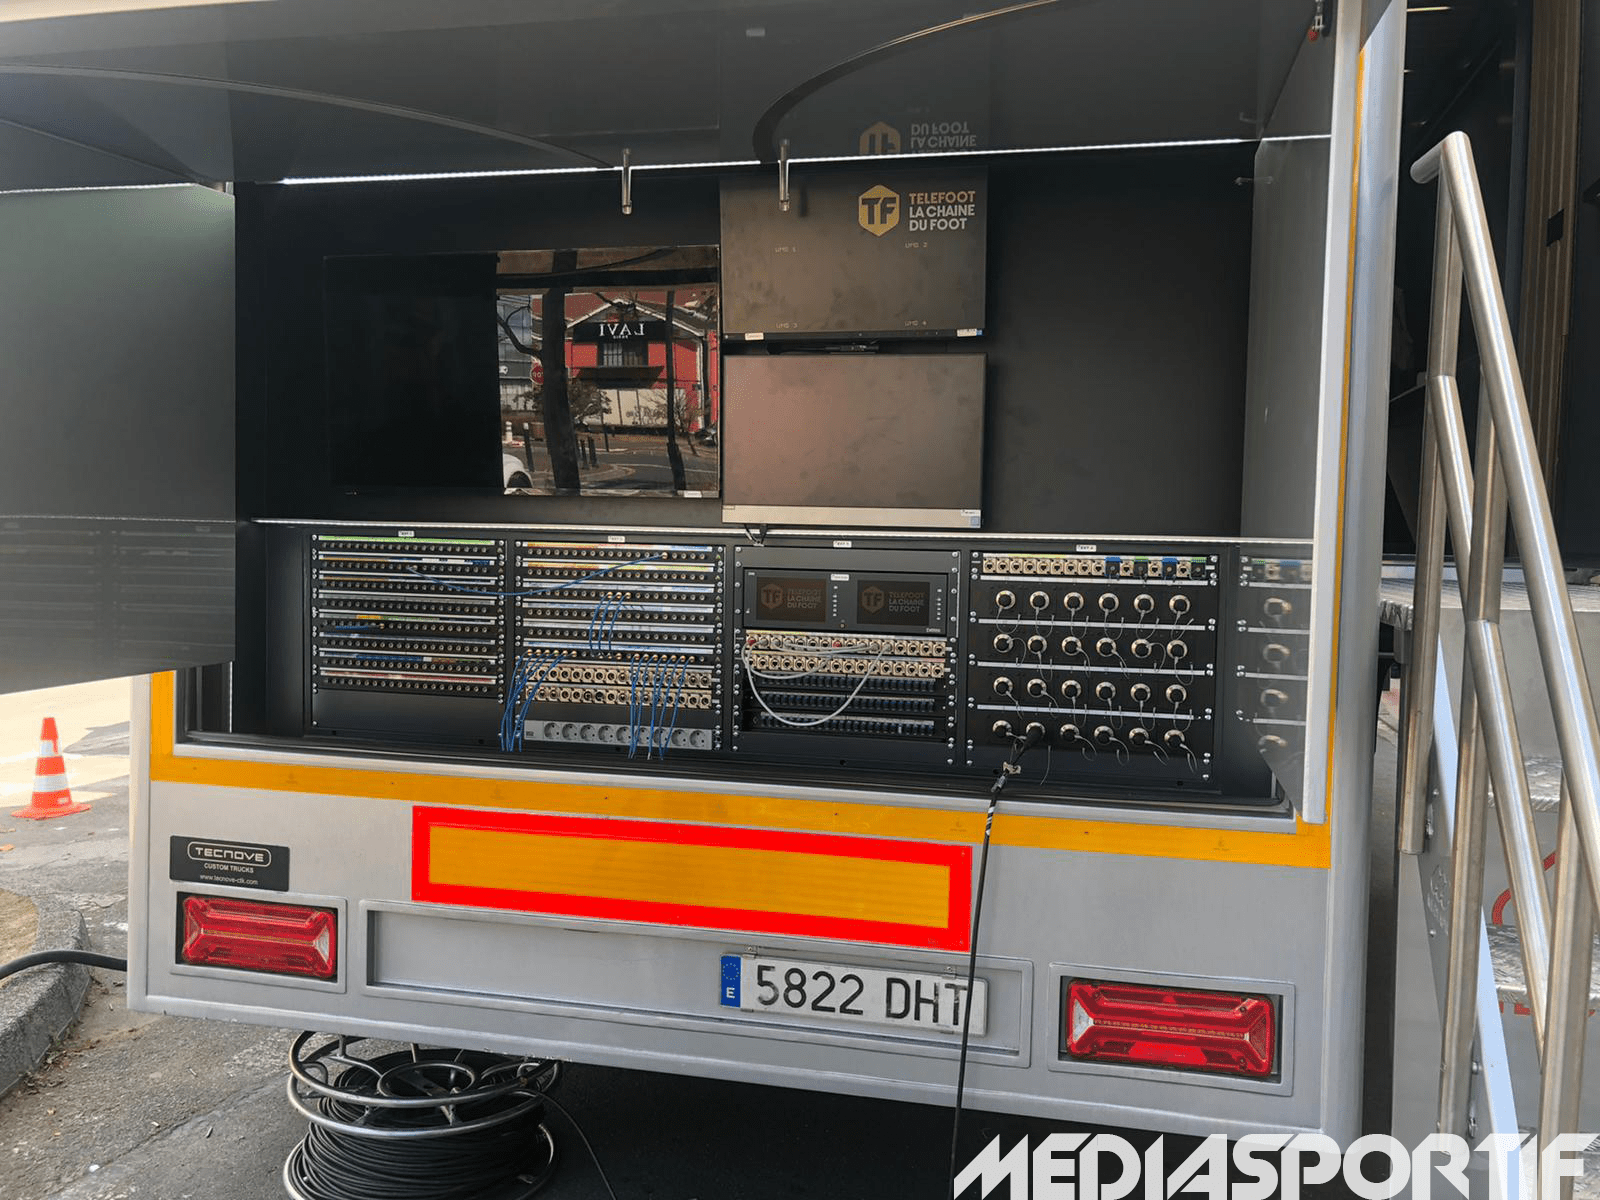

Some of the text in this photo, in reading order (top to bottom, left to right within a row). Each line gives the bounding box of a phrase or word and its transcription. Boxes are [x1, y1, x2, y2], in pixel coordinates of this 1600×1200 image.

[908, 190, 976, 205] TELEFOOT
[861, 196, 897, 225] TF
[909, 204, 976, 218] LA CHAINE
[909, 218, 968, 231] DU FOOT
[195, 847, 264, 862] TECNOVE
[203, 862, 254, 873] CUSTOM TRUCKS
[726, 986, 735, 999] E
[756, 963, 969, 1027] 5822 DHT
